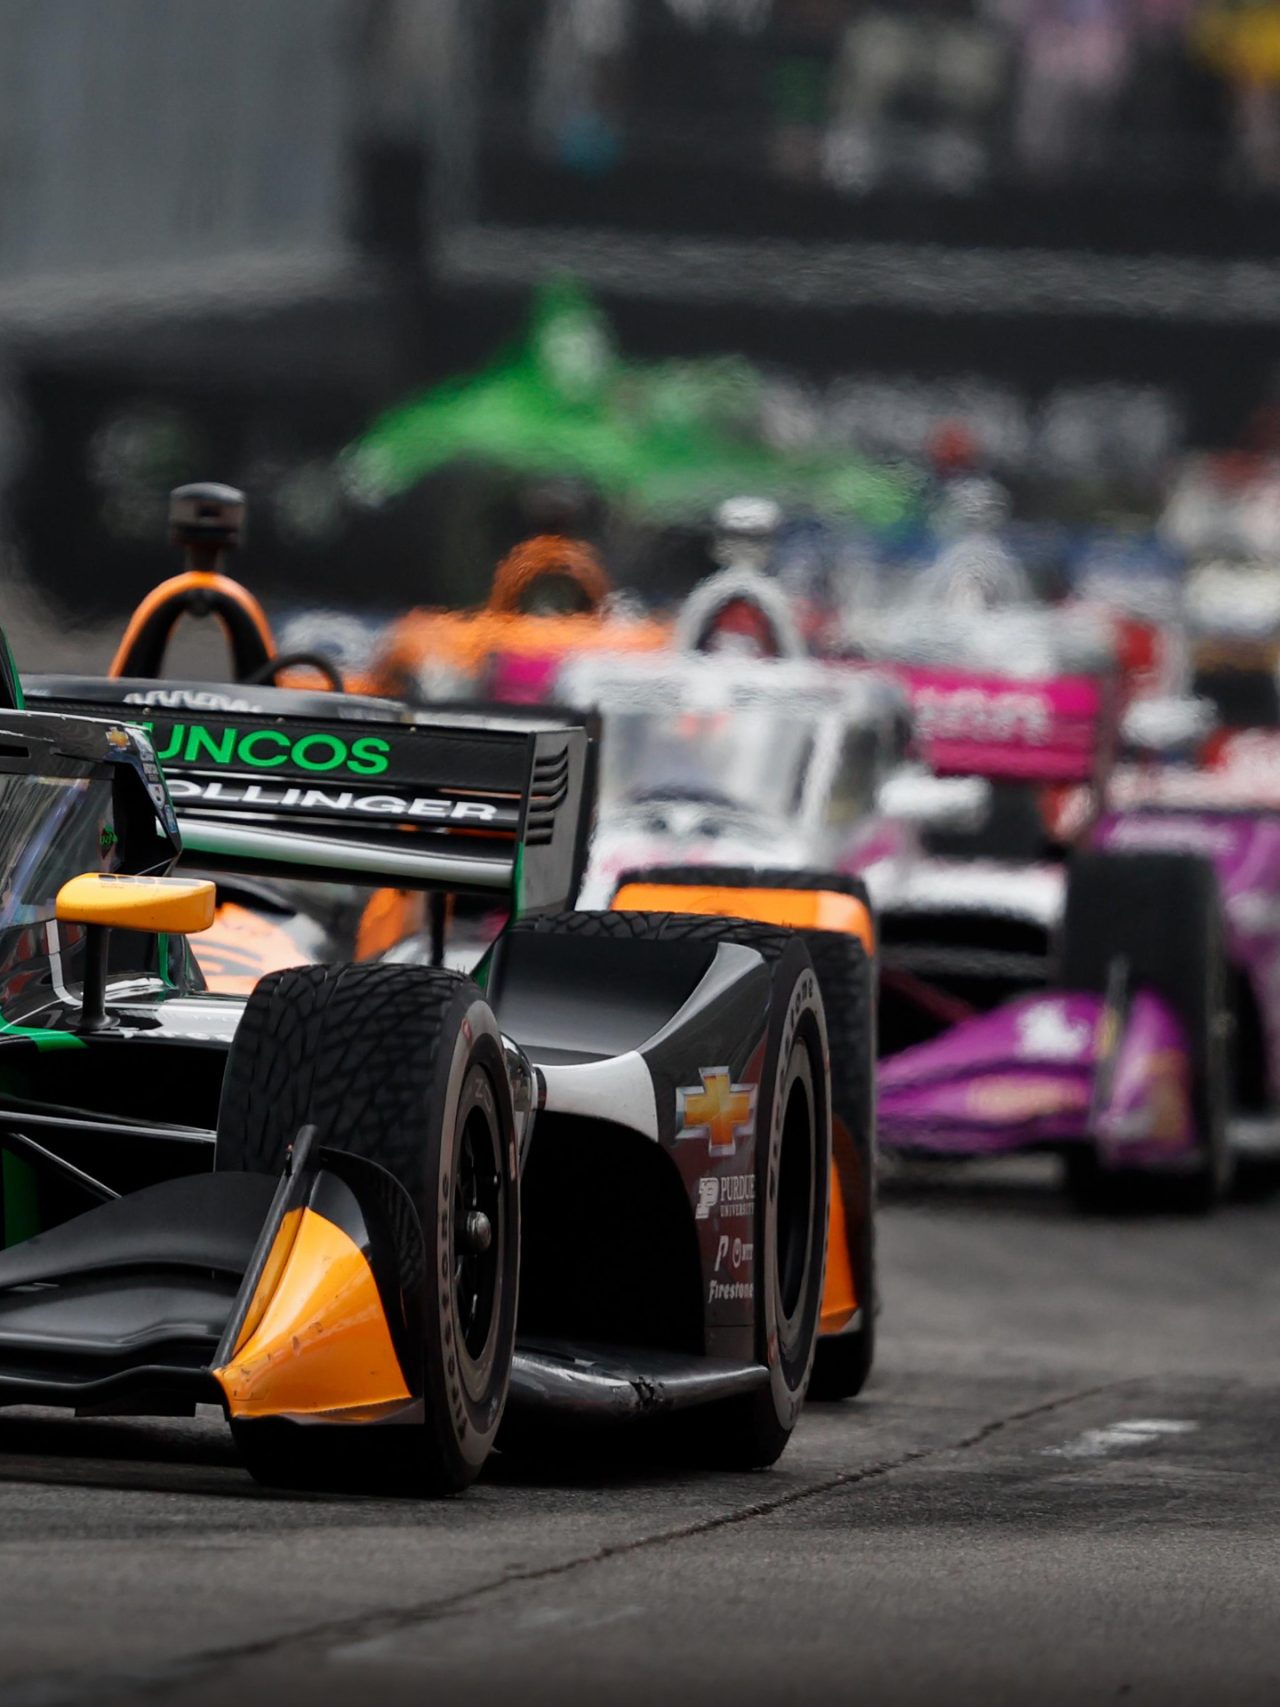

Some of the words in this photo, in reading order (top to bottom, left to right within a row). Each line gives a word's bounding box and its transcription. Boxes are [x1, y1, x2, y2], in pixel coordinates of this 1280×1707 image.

[126, 720, 391, 775] UNCOS
[164, 778, 497, 821] OLLINGER
[720, 1174, 755, 1201] PURDUE
[708, 1279, 754, 1304] Firestone
